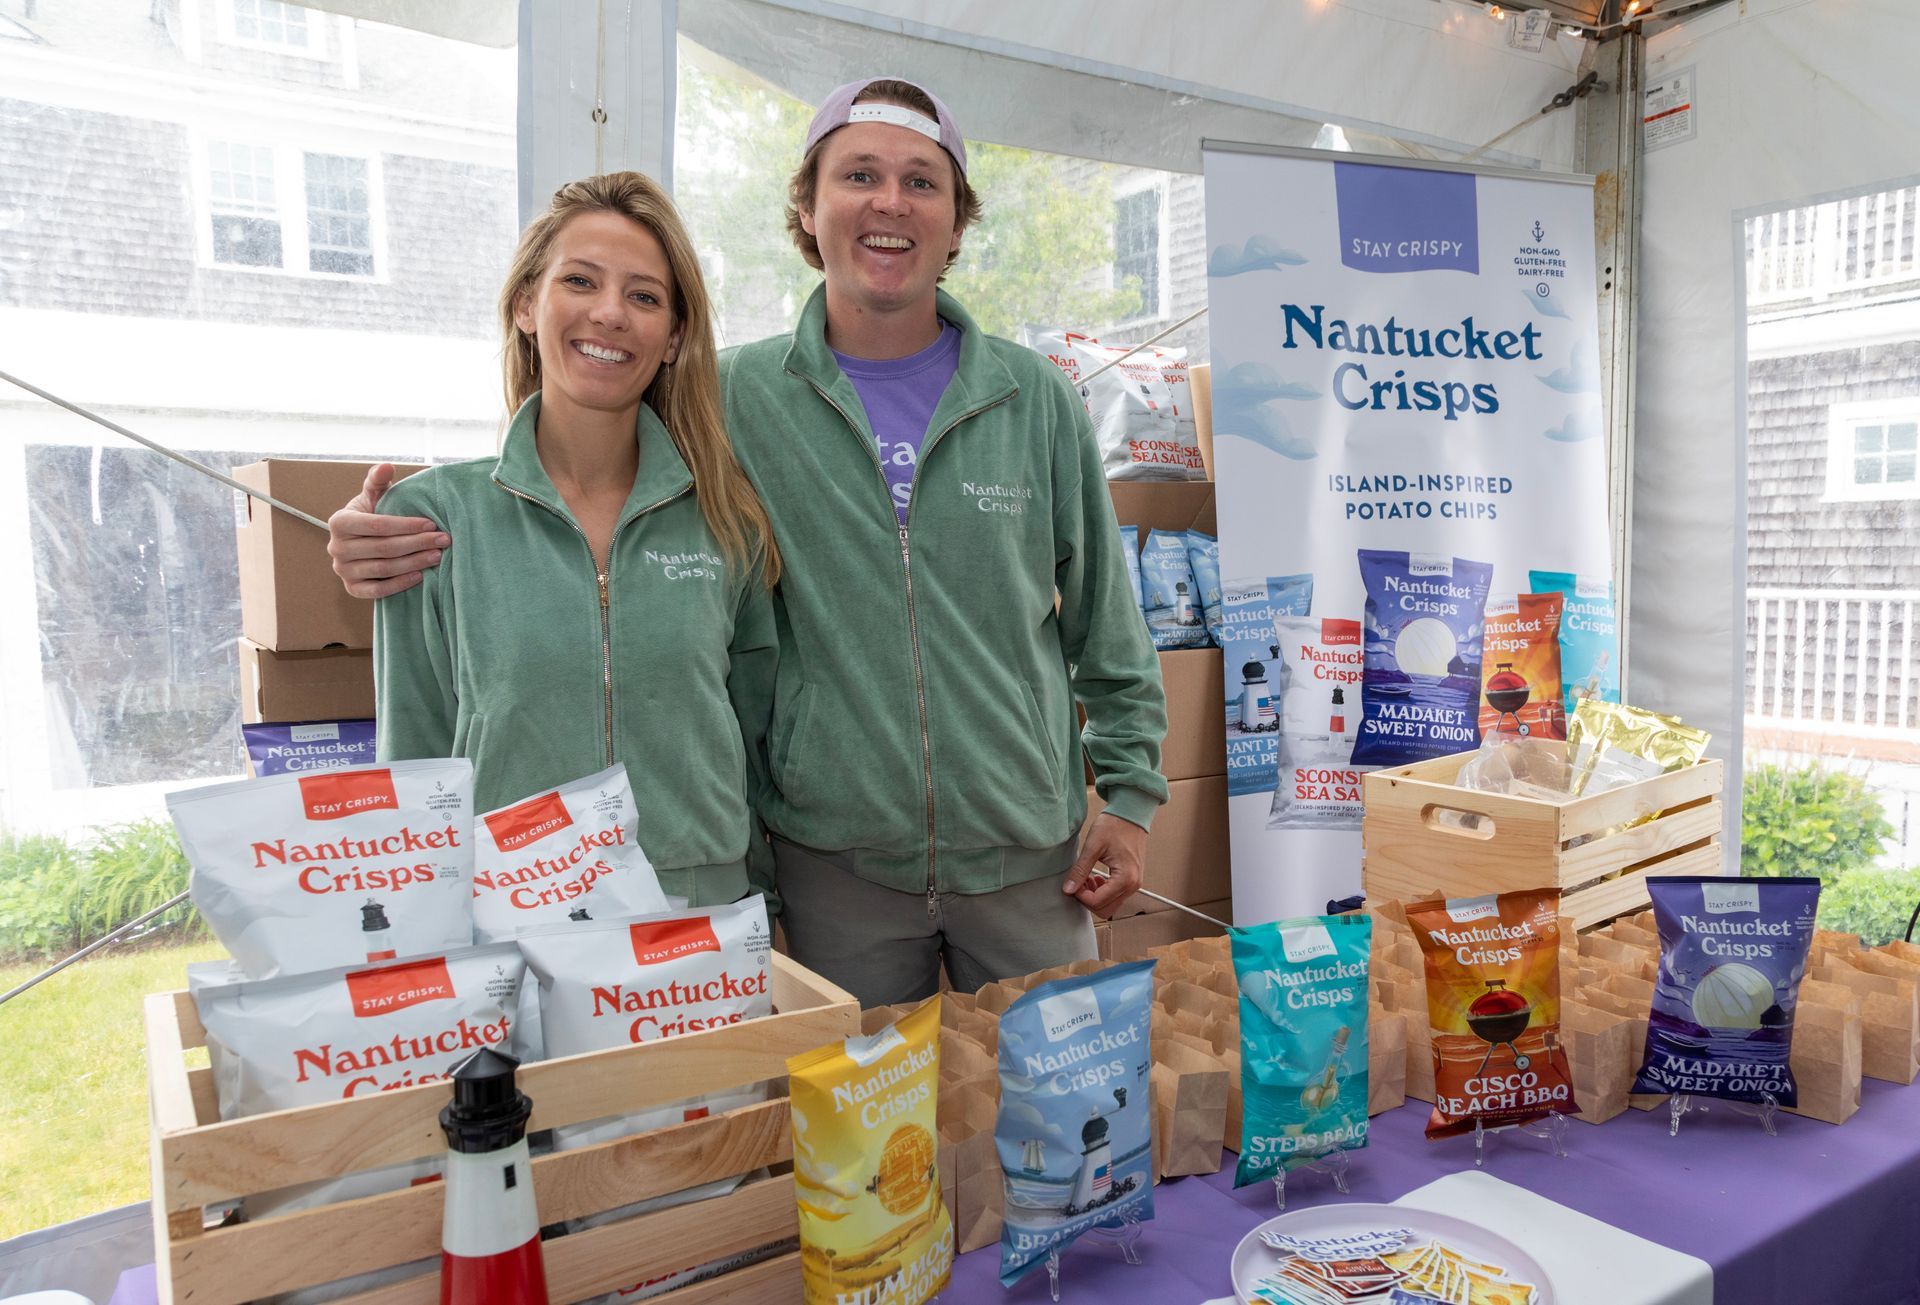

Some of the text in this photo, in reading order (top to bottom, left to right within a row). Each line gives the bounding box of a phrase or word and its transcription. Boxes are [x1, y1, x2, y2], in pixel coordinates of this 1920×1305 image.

[1353, 238, 1463, 258] STAY CRISPY
[1520, 247, 1560, 256] NON-GMO
[1514, 257, 1567, 268] GLUTEN-FREE
[1518, 268, 1564, 278] DAIRY-FREE
[1280, 304, 1543, 361] Nantucket
[1333, 362, 1499, 421] Crisps
[1129, 439, 1181, 451] SCONSE
[962, 482, 1033, 499] Nantucket
[1329, 474, 1512, 495] ISLAND-INSPIRED
[978, 497, 1022, 516] Crisps
[1345, 501, 1497, 520] POTATO CHIPS
[1384, 576, 1471, 599] Nantucket
[1400, 595, 1458, 616] Crisps
[1484, 618, 1541, 634] ntucket
[1567, 615, 1615, 635] Crisps
[1301, 645, 1364, 664] Nantuck
[1483, 636, 1529, 652] Crisps
[1377, 704, 1466, 724] MADAKET
[1365, 720, 1474, 742] SWEET ONION
[267, 742, 366, 759] Nantucket
[285, 757, 351, 771] Crisps
[1228, 755, 1258, 768] ACK
[1295, 786, 1362, 801] SEA SA
[313, 795, 388, 815] STAY CRISPY
[503, 817, 564, 846] STAY CRISPY
[251, 824, 461, 868] Nantucket
[473, 824, 625, 898] Nantucket
[298, 862, 436, 894] Crisps
[510, 860, 614, 909] Crisps
[1708, 901, 1725, 909] STAY
[1428, 920, 1534, 946] Nantucket
[1680, 915, 1792, 936] Nantucket
[643, 940, 712, 961] STAY CRISPY
[1307, 945, 1330, 954] CRISPY
[1456, 945, 1522, 966] Crisps
[1701, 937, 1773, 960] Crisps
[1263, 958, 1368, 990] Nantucket
[362, 986, 444, 1010] STAY CRISPY
[592, 969, 767, 1017] Nantucket
[1287, 987, 1353, 1010] Crisps
[1067, 1012, 1094, 1029] CRISPY
[293, 1015, 511, 1083] Nantucket
[1024, 1023, 1140, 1079] Nantucket
[832, 1040, 937, 1114] Nantucket
[1049, 1059, 1125, 1096] Crisps
[1663, 1055, 1785, 1079] MADAKET
[1464, 1071, 1538, 1096] CISCO
[1646, 1066, 1792, 1093] SWEET ONION
[861, 1080, 930, 1129] Crisps
[1437, 1084, 1569, 1116] BEACH BBQ
[1250, 1133, 1318, 1153] STEPS
[1275, 1228, 1415, 1249] Nantucket
[1307, 1238, 1403, 1257] Crisps
